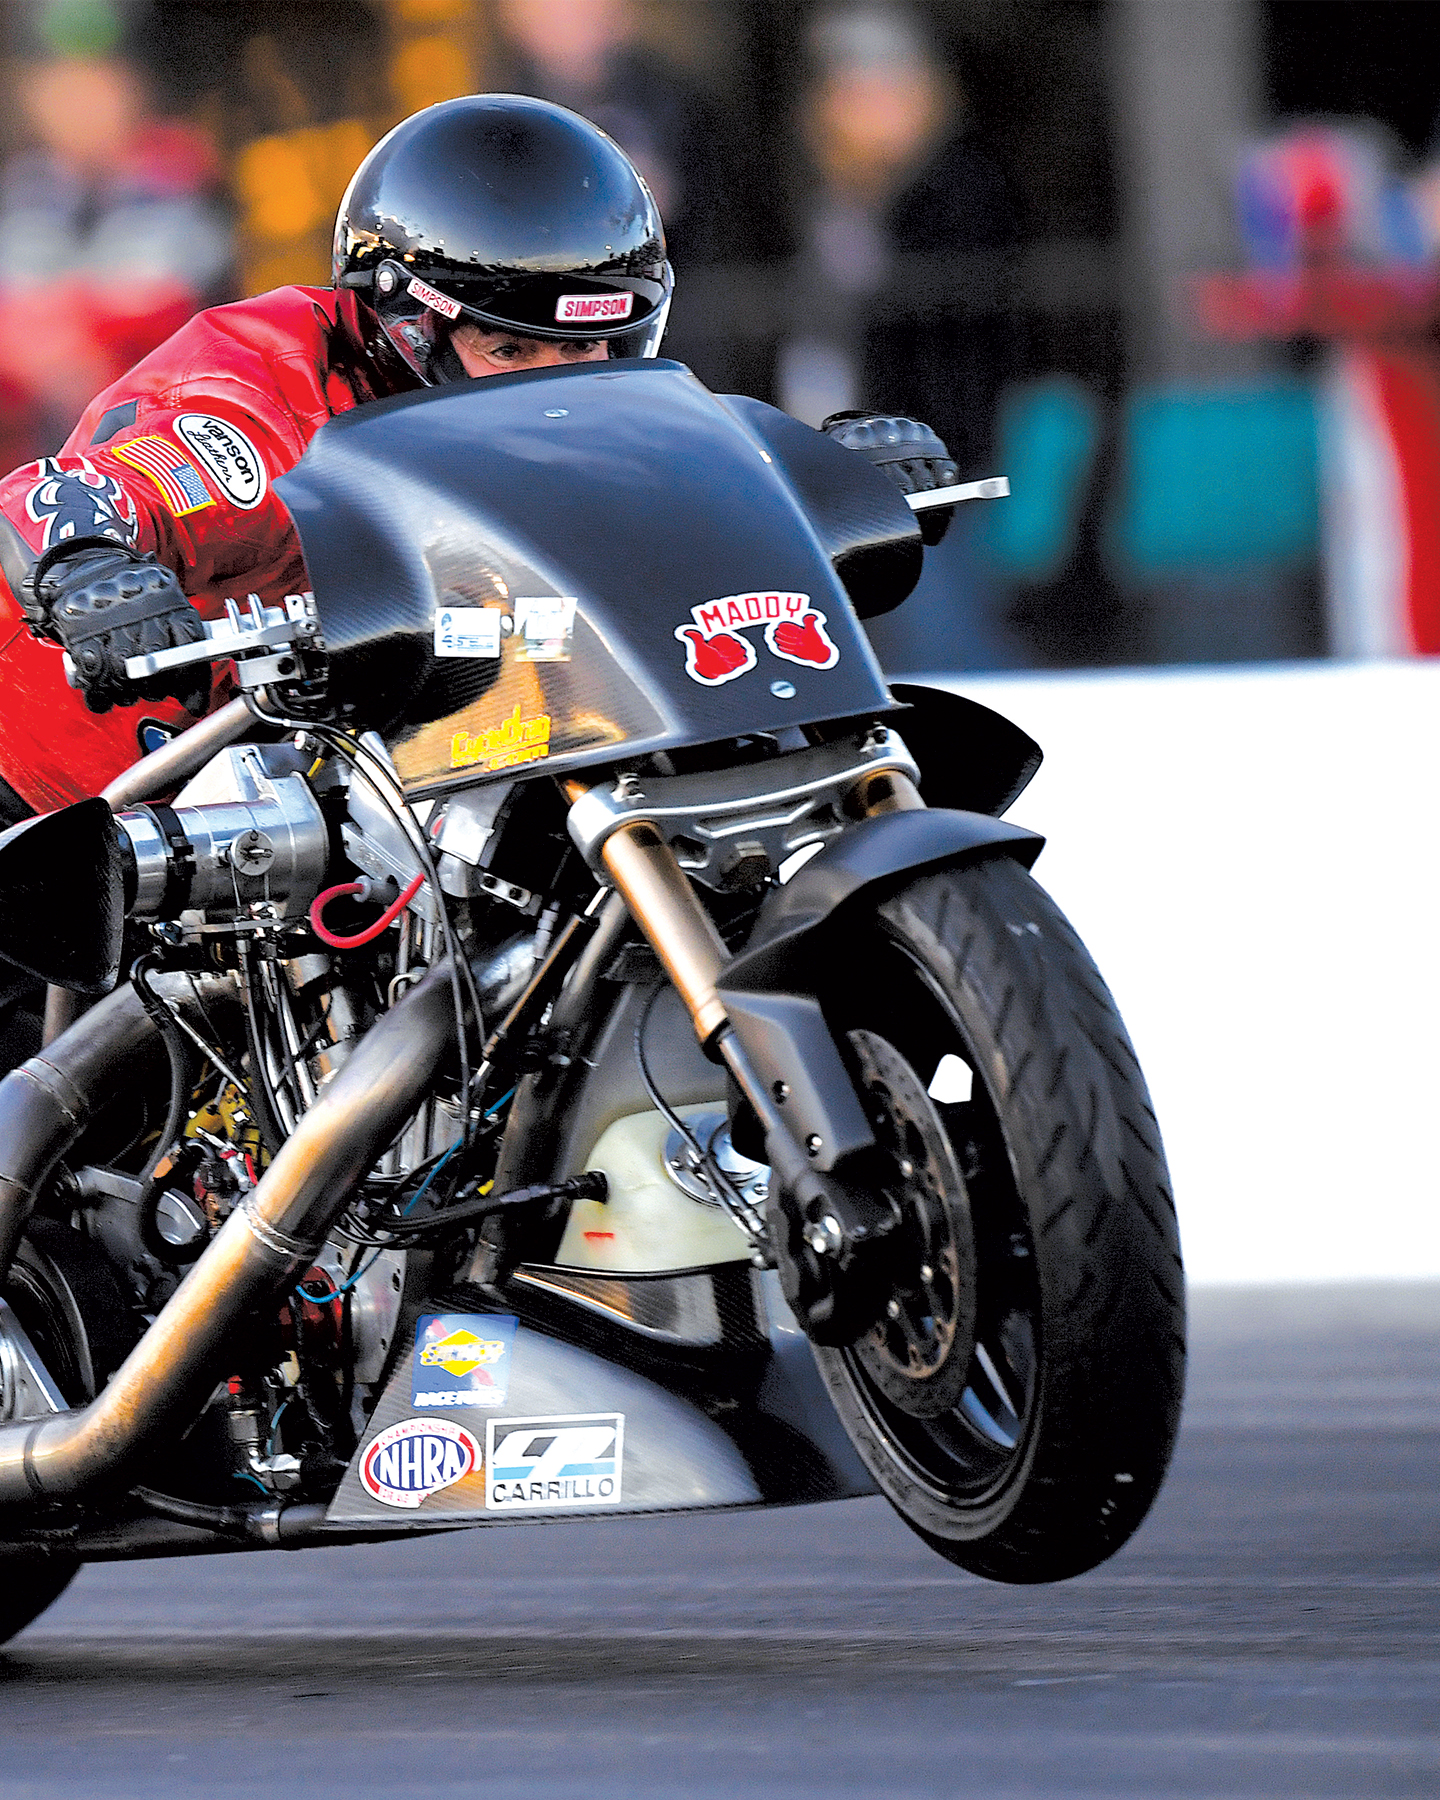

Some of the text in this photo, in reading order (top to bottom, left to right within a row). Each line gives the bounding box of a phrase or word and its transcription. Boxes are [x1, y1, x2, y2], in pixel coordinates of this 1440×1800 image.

[410, 281, 456, 317] SIMPSON
[564, 297, 628, 318] SIMPSON
[201, 419, 255, 485] vanson
[699, 595, 802, 633] MADDY
[379, 1436, 462, 1490] NHRA
[492, 1478, 615, 1503] CARRILLO
